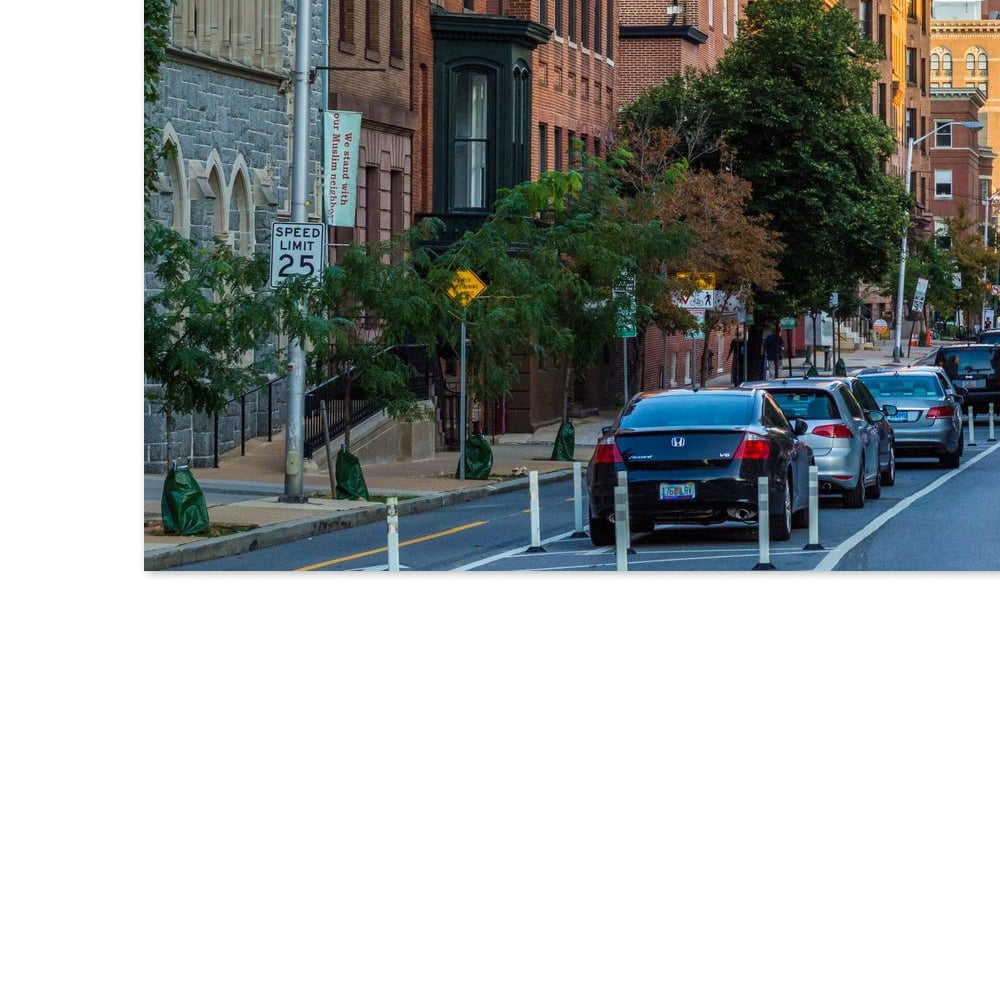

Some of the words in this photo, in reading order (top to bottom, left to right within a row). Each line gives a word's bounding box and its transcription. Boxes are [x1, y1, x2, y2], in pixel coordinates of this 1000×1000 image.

[344, 132, 352, 148] We
[331, 133, 340, 171] Muslim
[342, 150, 351, 180] stand
[340, 183, 349, 206] with
[275, 226, 321, 238] SPEED
[280, 240, 315, 251] LIMIT
[278, 253, 315, 278] 25
